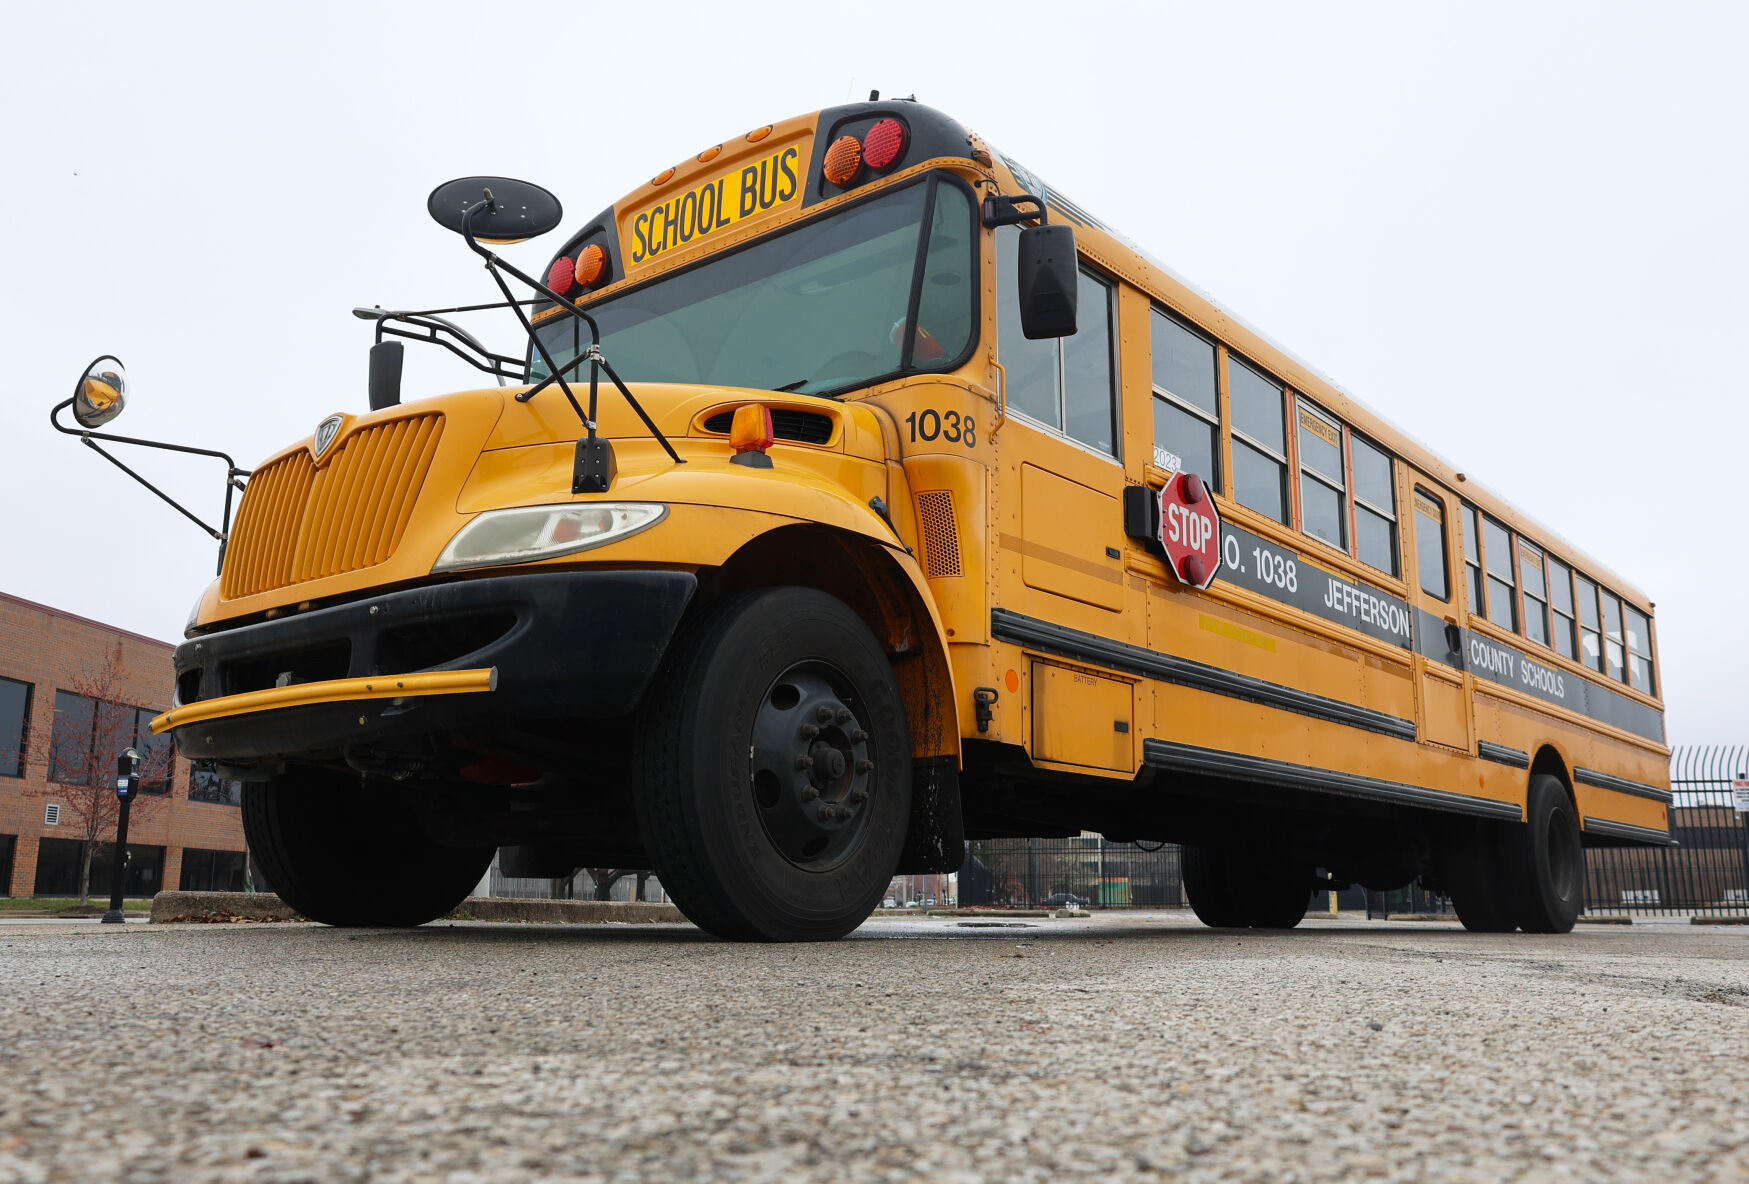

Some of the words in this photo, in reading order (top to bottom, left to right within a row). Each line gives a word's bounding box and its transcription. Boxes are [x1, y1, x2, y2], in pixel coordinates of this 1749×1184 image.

[632, 178, 731, 263] SCHOOL
[739, 147, 798, 219] BUS
[905, 408, 976, 448] 1038
[1153, 447, 1177, 473] 2023
[1168, 502, 1212, 554] STOP
[1221, 531, 1246, 574] O.
[1252, 546, 1298, 593] 1038
[1324, 577, 1410, 639] JEFFERSON
[1470, 639, 1514, 678] COUNTY
[1520, 660, 1565, 698] SCHOOLS
[1073, 673, 1098, 687] BATTERY
